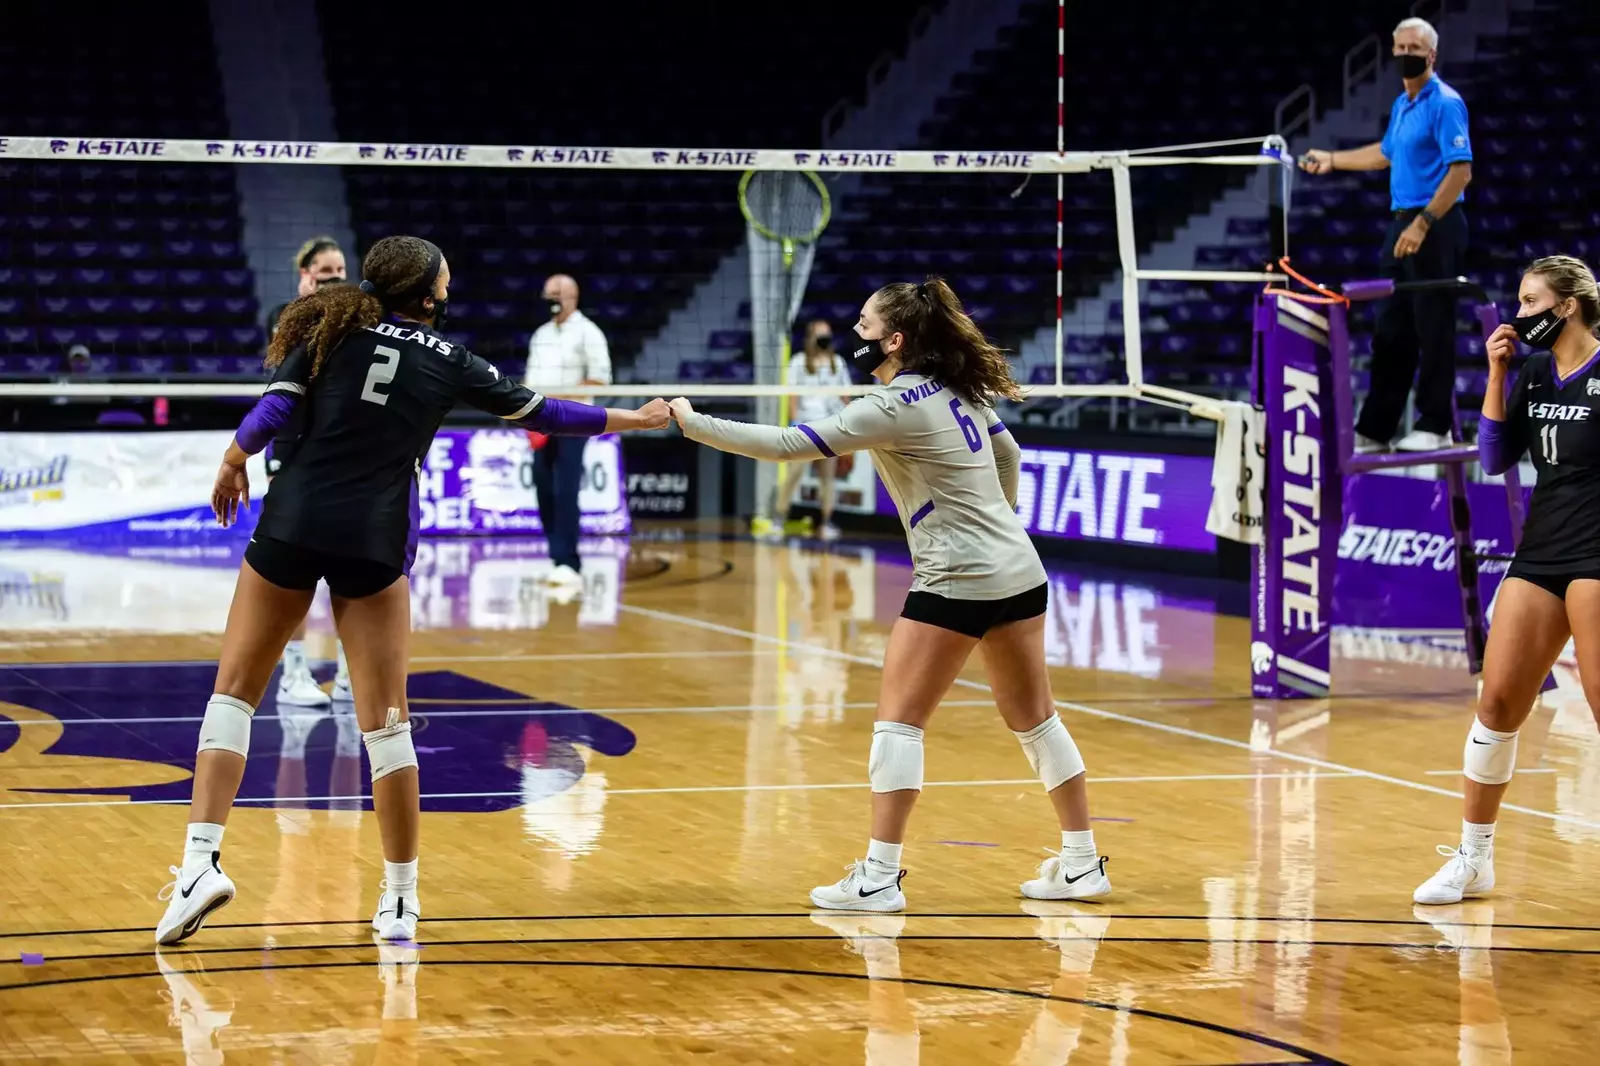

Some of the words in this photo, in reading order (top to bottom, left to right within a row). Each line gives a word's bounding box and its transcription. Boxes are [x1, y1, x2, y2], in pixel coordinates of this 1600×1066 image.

[76, 139, 166, 156] K-STATE
[232, 142, 318, 158] K-STATE
[383, 145, 469, 161] K-STATE
[531, 147, 616, 163] K-STATE
[676, 150, 758, 165] K-STATE
[817, 152, 897, 166] K-STATE
[956, 153, 1033, 168] K-STATE
[1526, 318, 1550, 341] K-STATE
[361, 323, 454, 356] DCATS
[361, 345, 400, 406] 2
[1528, 401, 1591, 421] K-STATE
[949, 397, 983, 454] 6
[1540, 424, 1559, 465] 11
[1283, 365, 1321, 633] K-STATE
